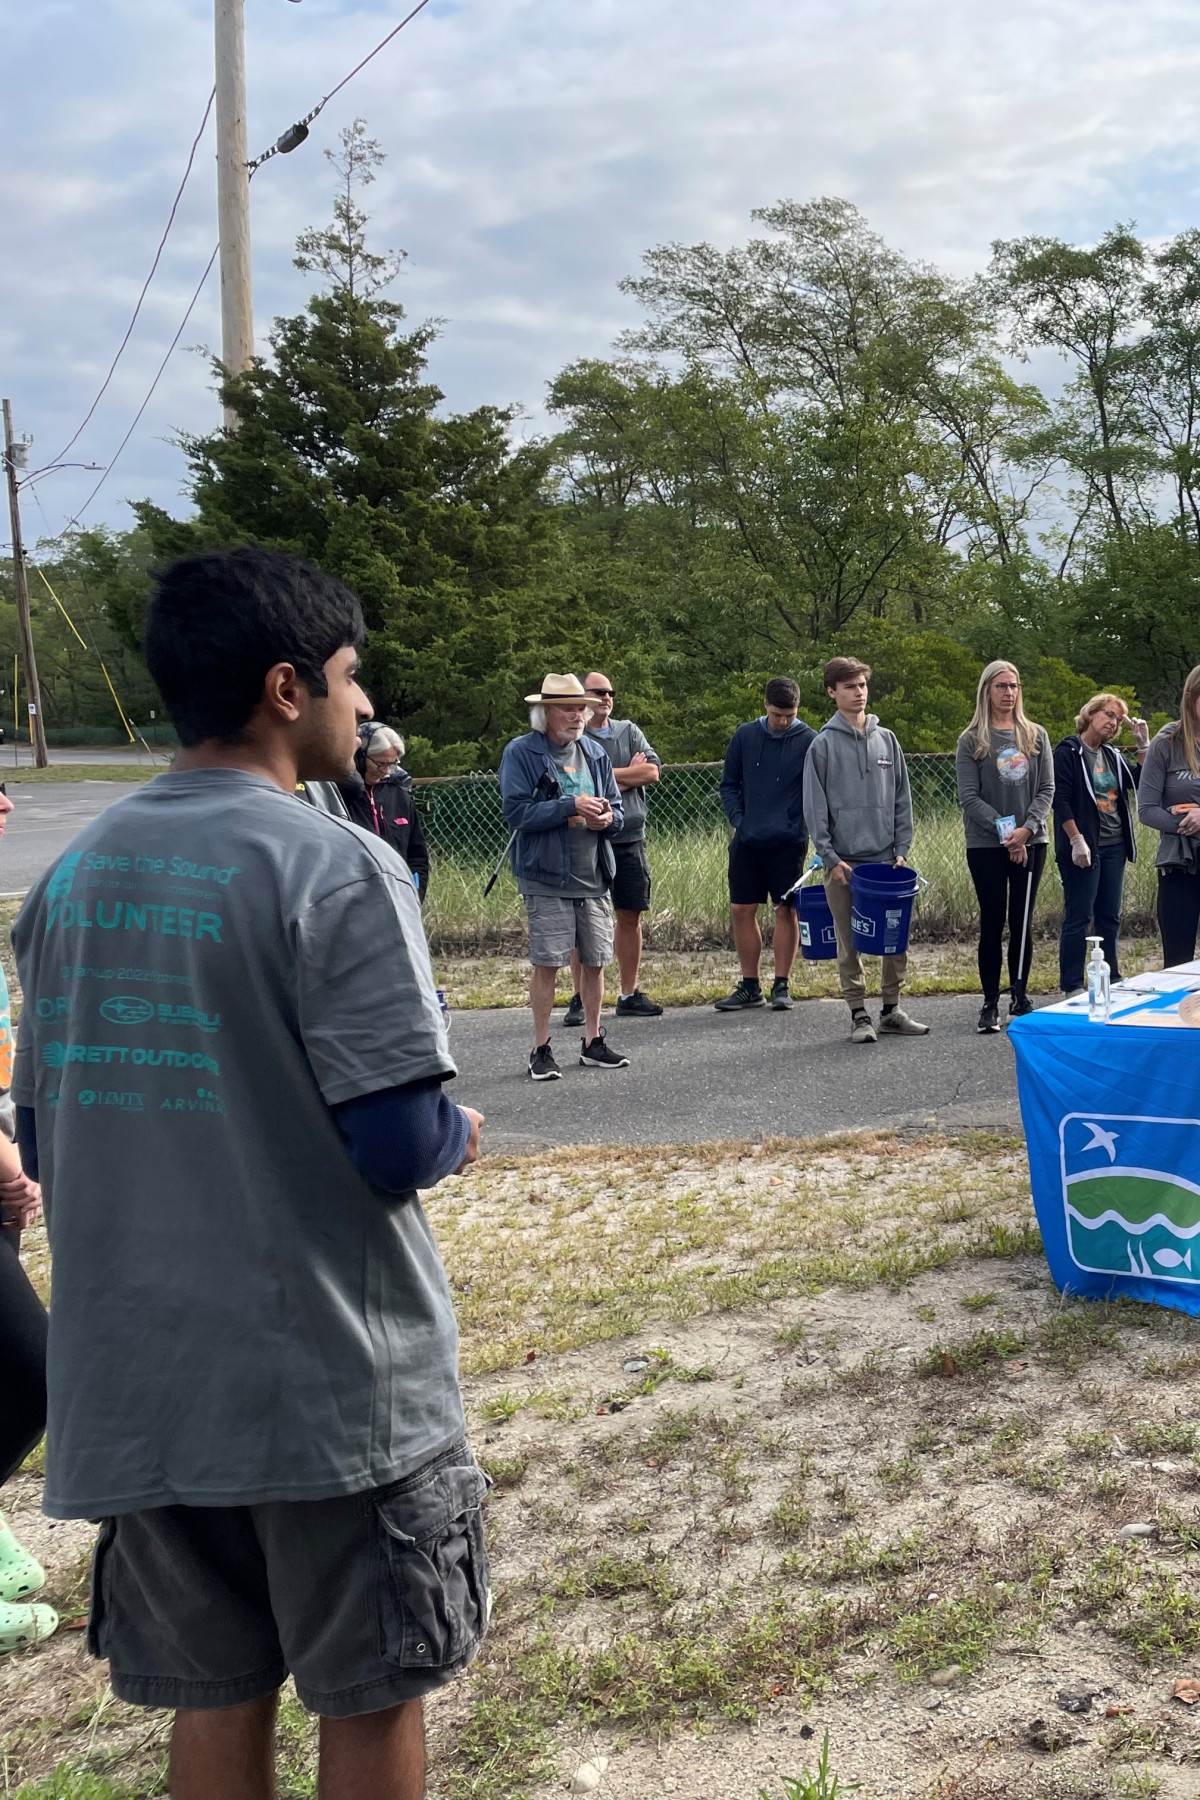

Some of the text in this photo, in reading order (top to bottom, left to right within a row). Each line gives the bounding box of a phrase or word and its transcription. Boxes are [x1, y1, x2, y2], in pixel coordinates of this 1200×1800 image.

[82, 851, 237, 886] Save the Sound
[46, 898, 223, 944] VOLUNTEER
